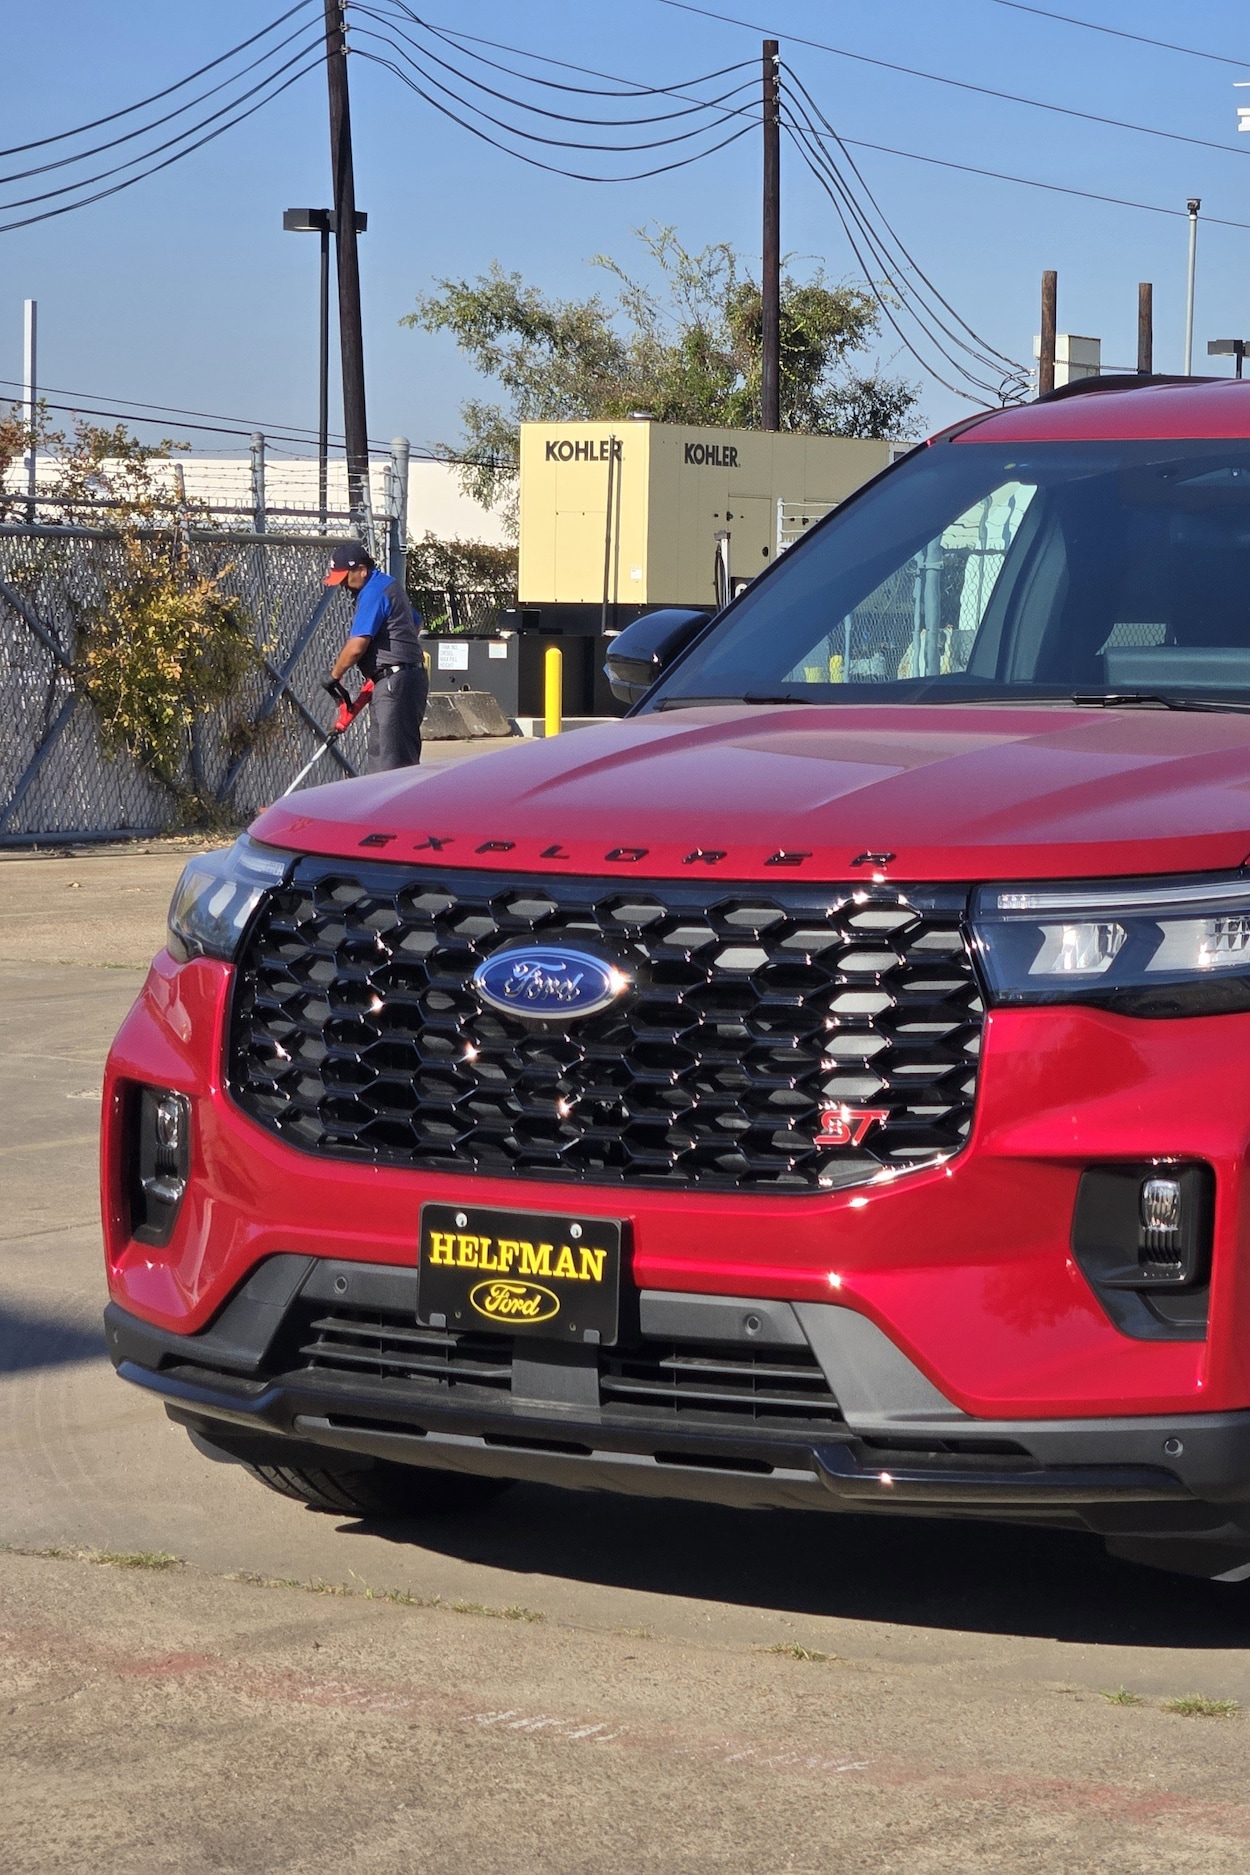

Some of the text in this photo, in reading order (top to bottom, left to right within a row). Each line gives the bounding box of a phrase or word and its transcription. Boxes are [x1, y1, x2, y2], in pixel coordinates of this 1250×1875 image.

[545, 440, 623, 462] KOHLER
[684, 443, 739, 468] KOHLER
[358, 833, 898, 868] EXPLORER
[504, 961, 585, 1001] Ford
[814, 1110, 891, 1146] ST
[429, 1231, 608, 1281] HELFMAN
[484, 1283, 542, 1316] Ford
